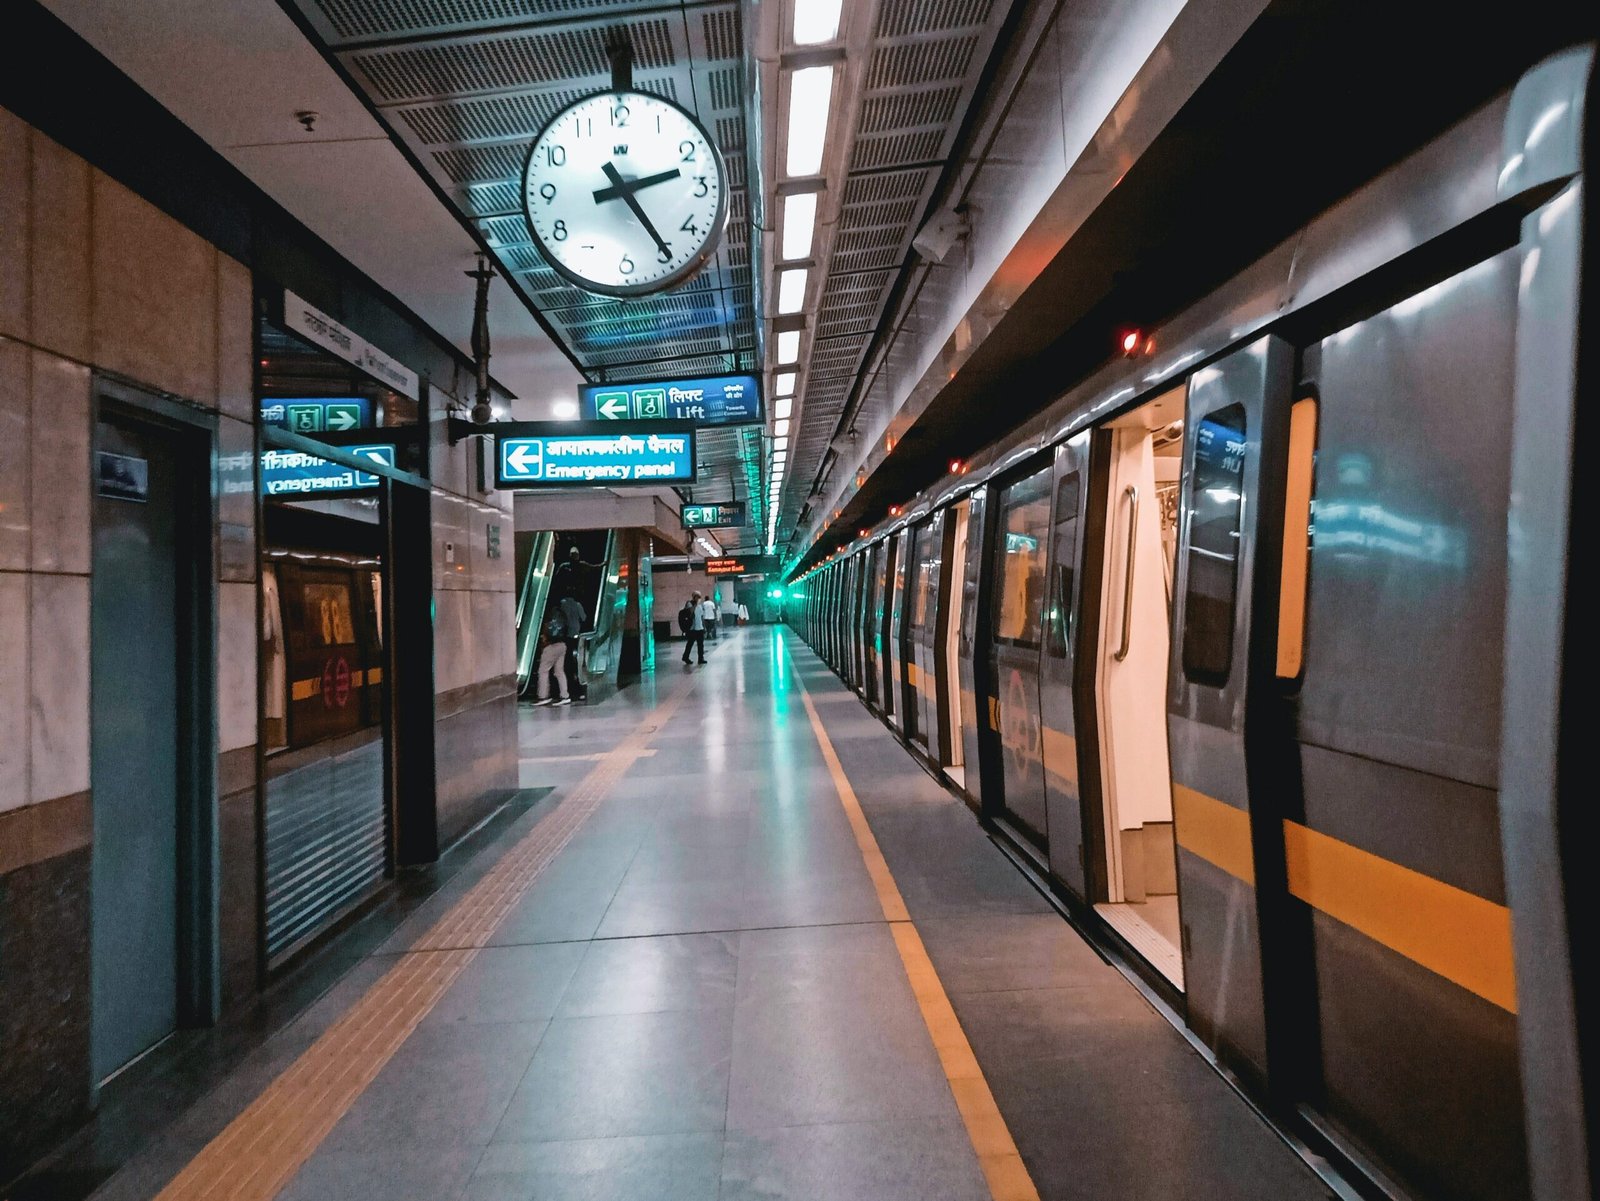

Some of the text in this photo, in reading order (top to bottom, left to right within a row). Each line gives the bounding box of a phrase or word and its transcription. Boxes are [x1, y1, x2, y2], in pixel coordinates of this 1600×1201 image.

[610, 105, 630, 128] 12
[576, 117, 592, 138] 11
[547, 144, 566, 167] 10
[679, 140, 696, 163] 2
[540, 183, 556, 205] 9
[693, 176, 708, 198] 3
[553, 219, 568, 241] 8
[679, 214, 698, 235] 4
[619, 254, 635, 274] 6
[668, 387, 703, 403] लिफ्ट
[676, 406, 705, 419] Lift
[647, 434, 685, 454] पैनल
[546, 461, 675, 480] Emergency panel
